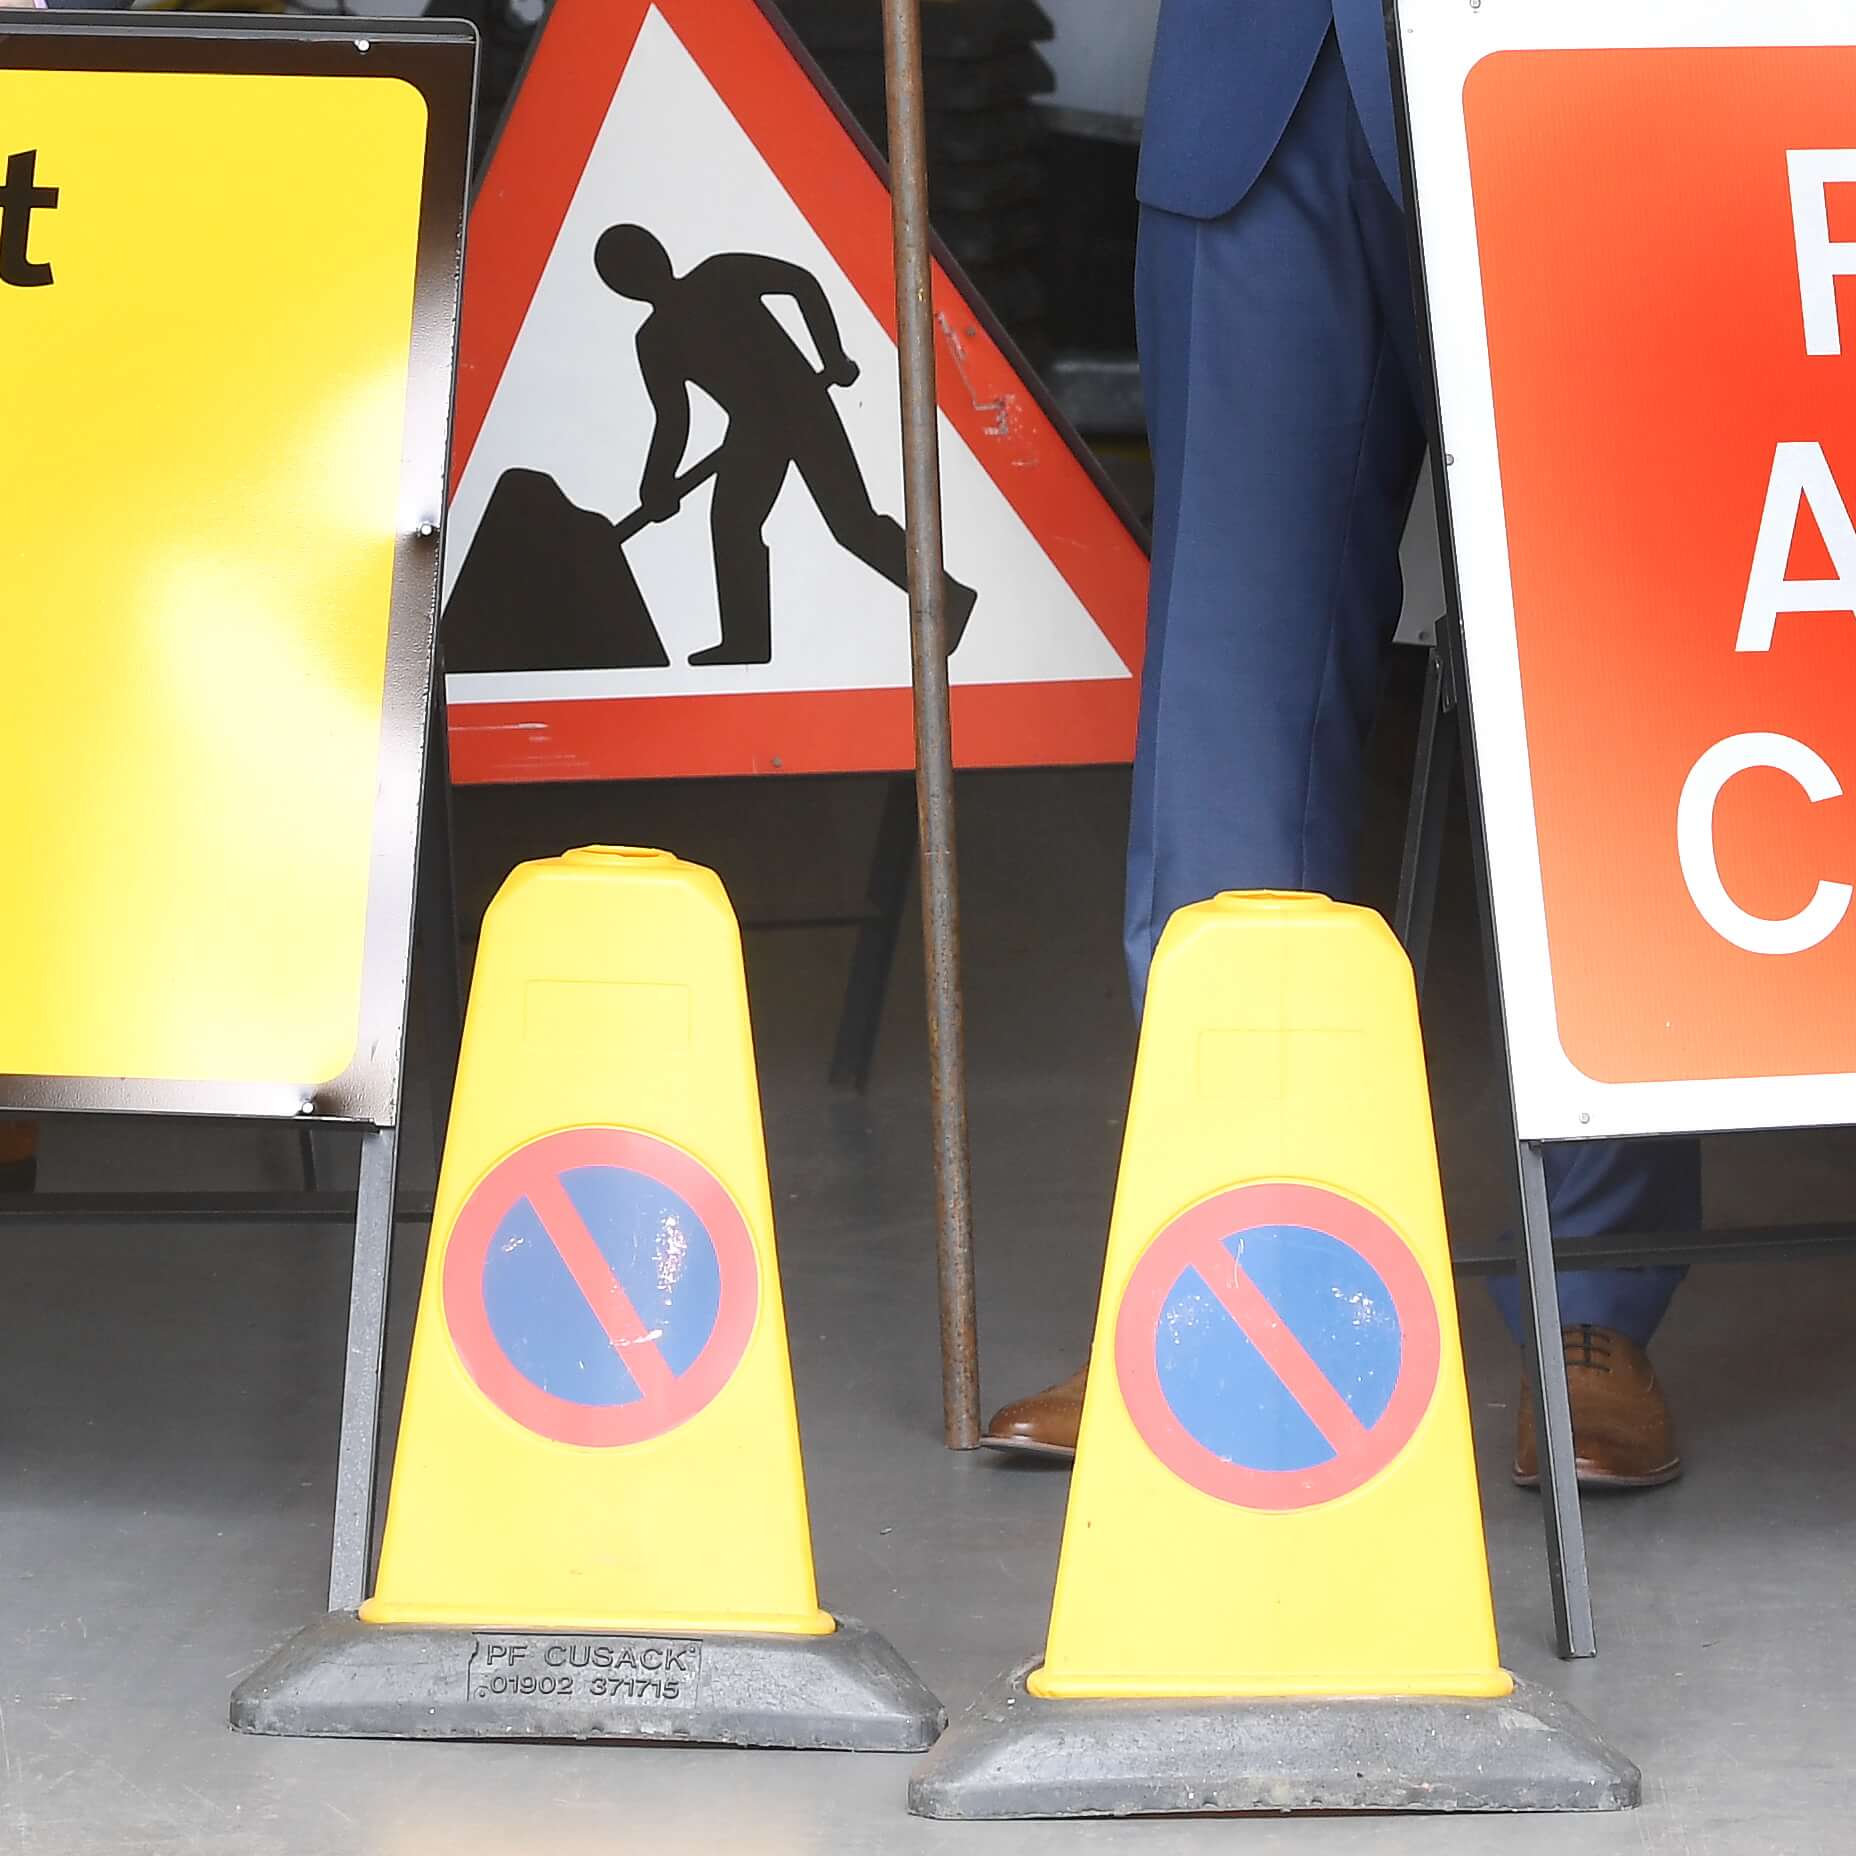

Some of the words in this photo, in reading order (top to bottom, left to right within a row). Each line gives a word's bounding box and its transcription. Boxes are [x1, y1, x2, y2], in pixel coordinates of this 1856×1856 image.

[485, 1643, 528, 1667] PF
[543, 1645, 688, 1672] CUSACK
[489, 1674, 574, 1696] 01902
[589, 1676, 680, 1700] 371715
